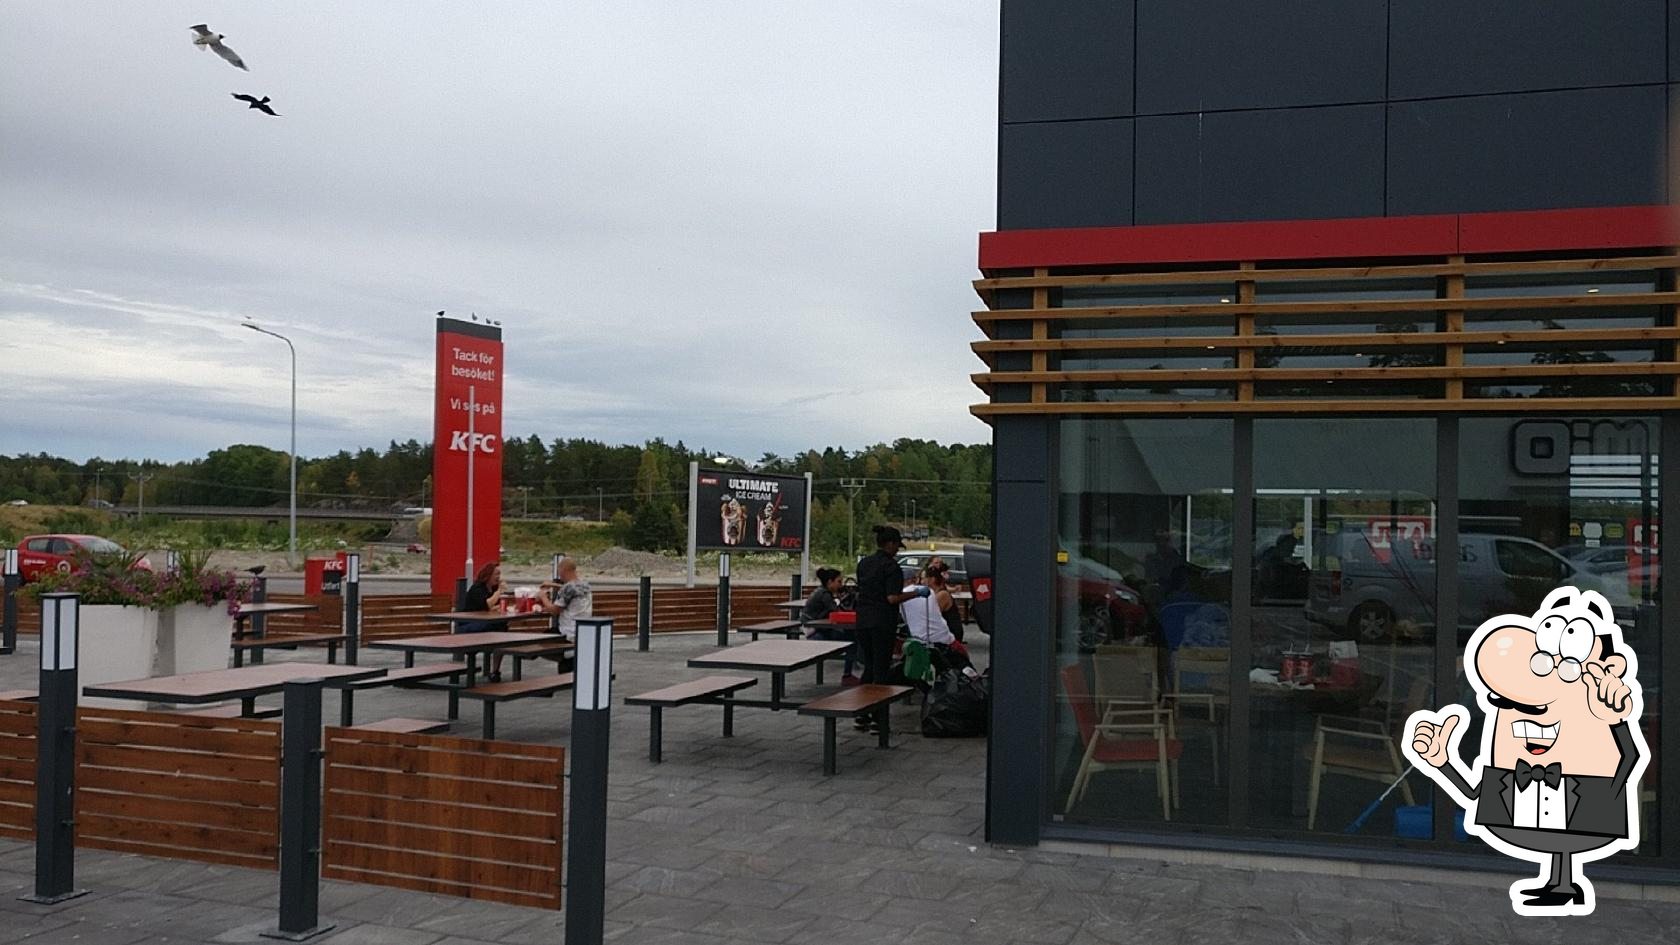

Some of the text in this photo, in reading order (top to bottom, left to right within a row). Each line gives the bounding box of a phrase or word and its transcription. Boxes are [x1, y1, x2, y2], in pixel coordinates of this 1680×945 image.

[453, 348, 494, 364] Tack för
[452, 365, 494, 381] besöket!
[450, 398, 495, 415] Vi ss på
[449, 431, 496, 453] KFC
[729, 479, 778, 492] ULTIMATE
[747, 492, 771, 500] CREAM
[781, 537, 801, 547] KFC
[323, 561, 343, 570] KFC
